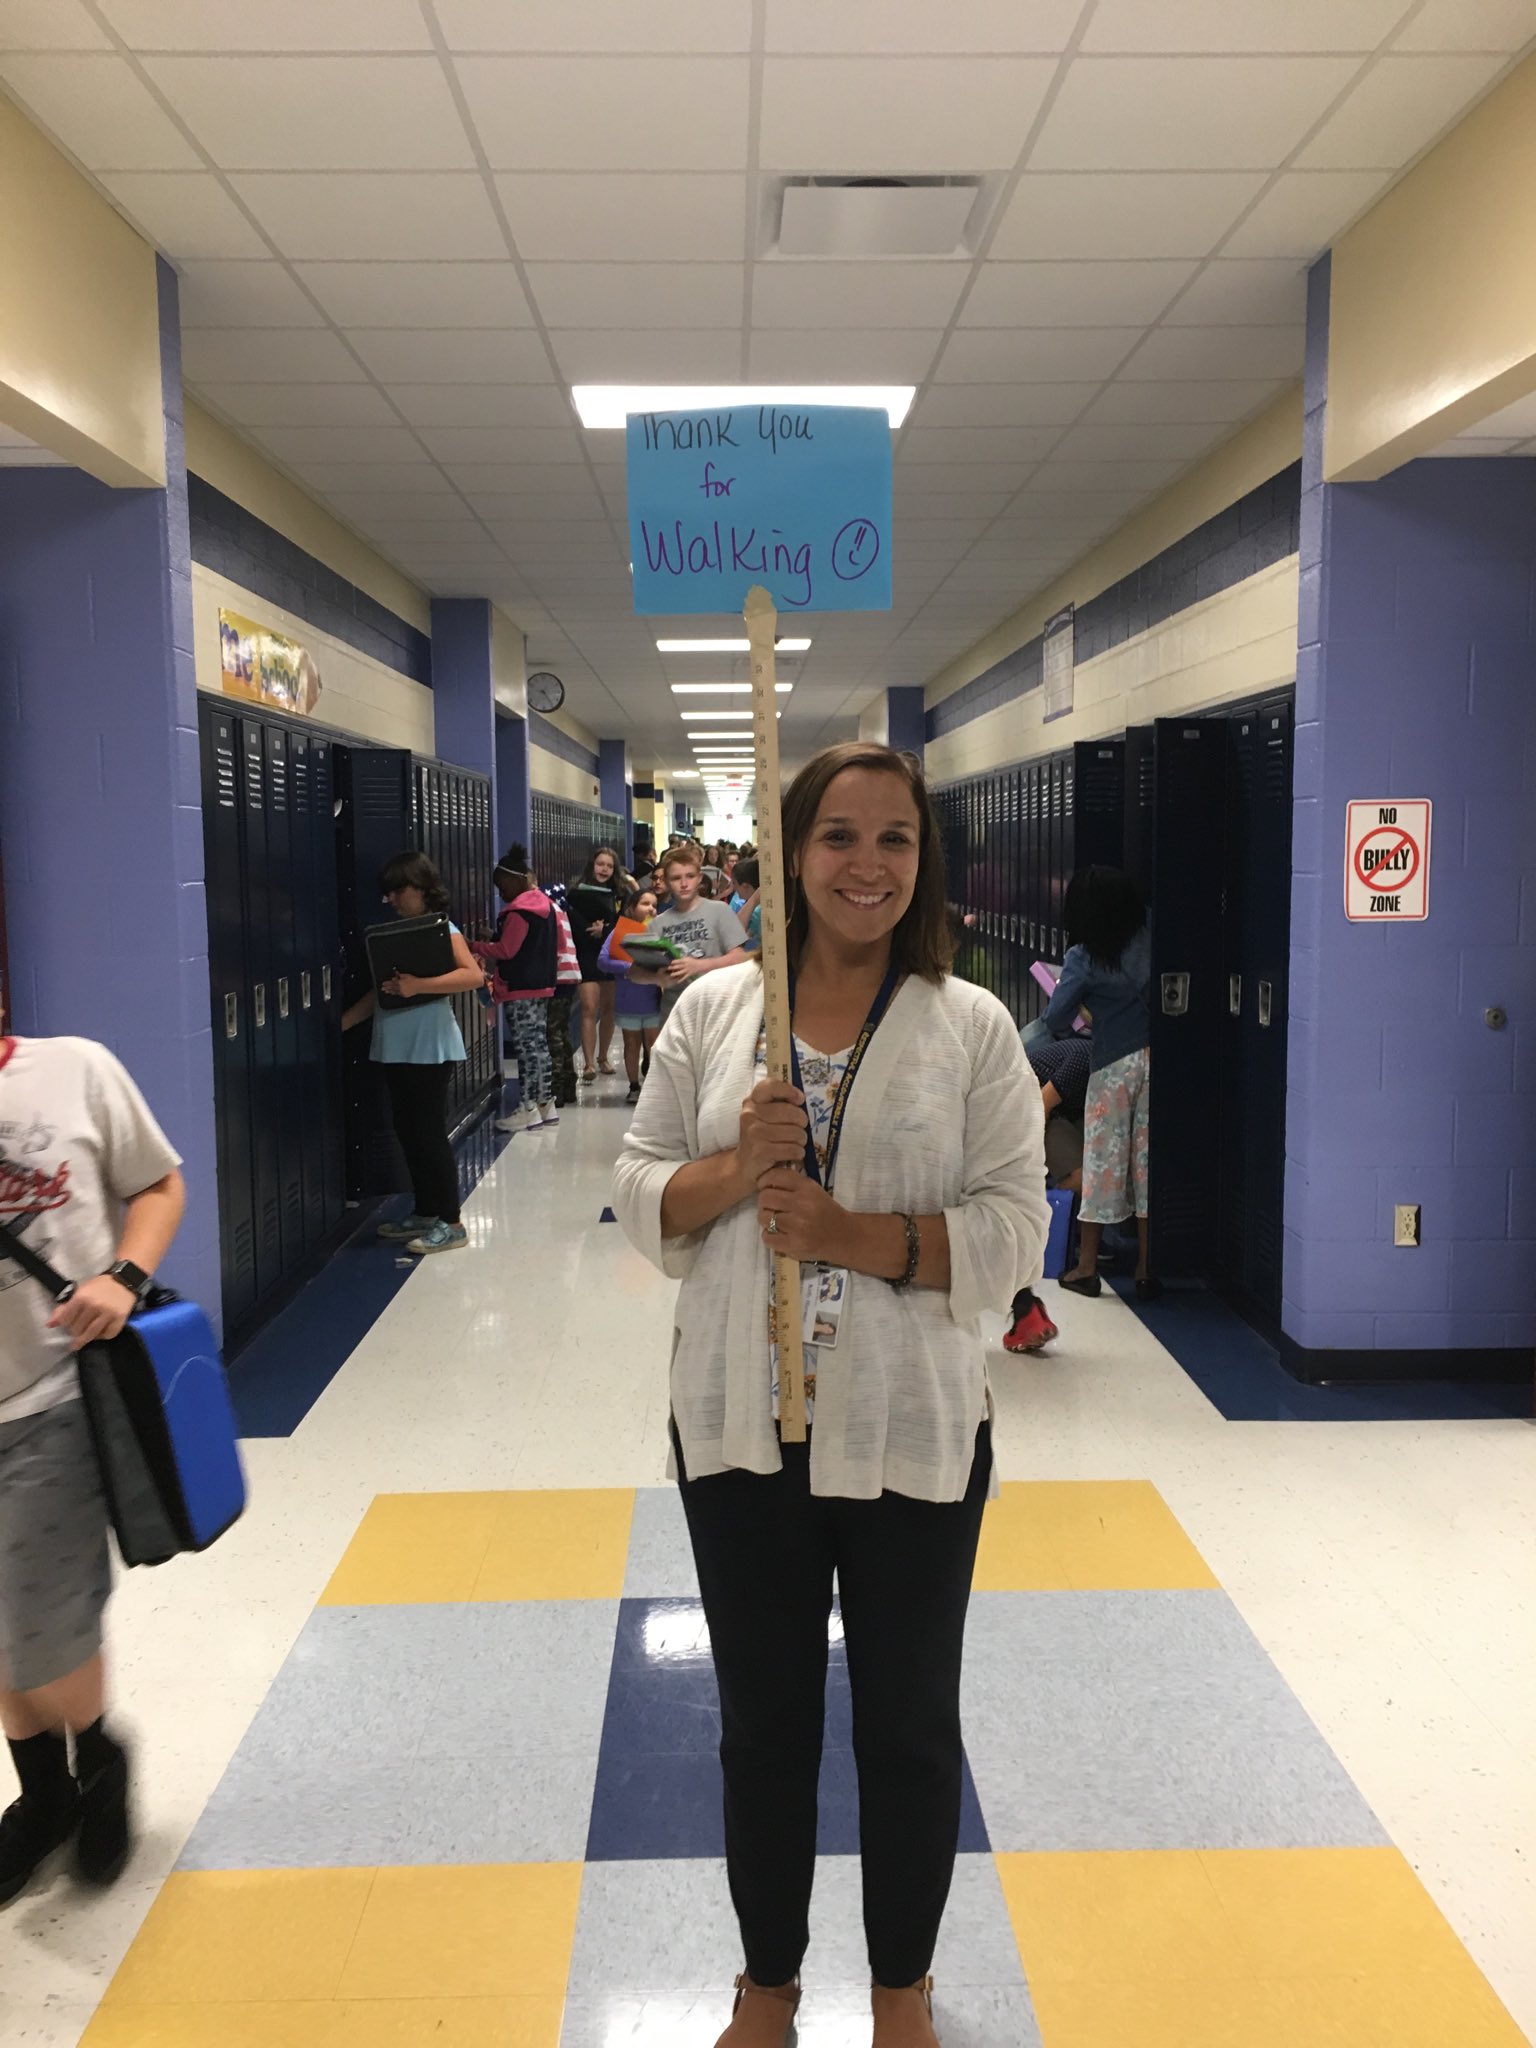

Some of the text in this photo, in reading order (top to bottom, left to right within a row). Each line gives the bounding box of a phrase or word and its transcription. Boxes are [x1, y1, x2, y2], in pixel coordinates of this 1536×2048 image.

[638, 411, 740, 451] Thank
[699, 461, 737, 498] for
[641, 520, 812, 606] Walking
[757, 689, 764, 698] 32
[758, 712, 765, 720] 31
[1378, 807, 1397, 825] NO
[1363, 848, 1410, 871] BULLY
[1369, 895, 1401, 912] ZONE
